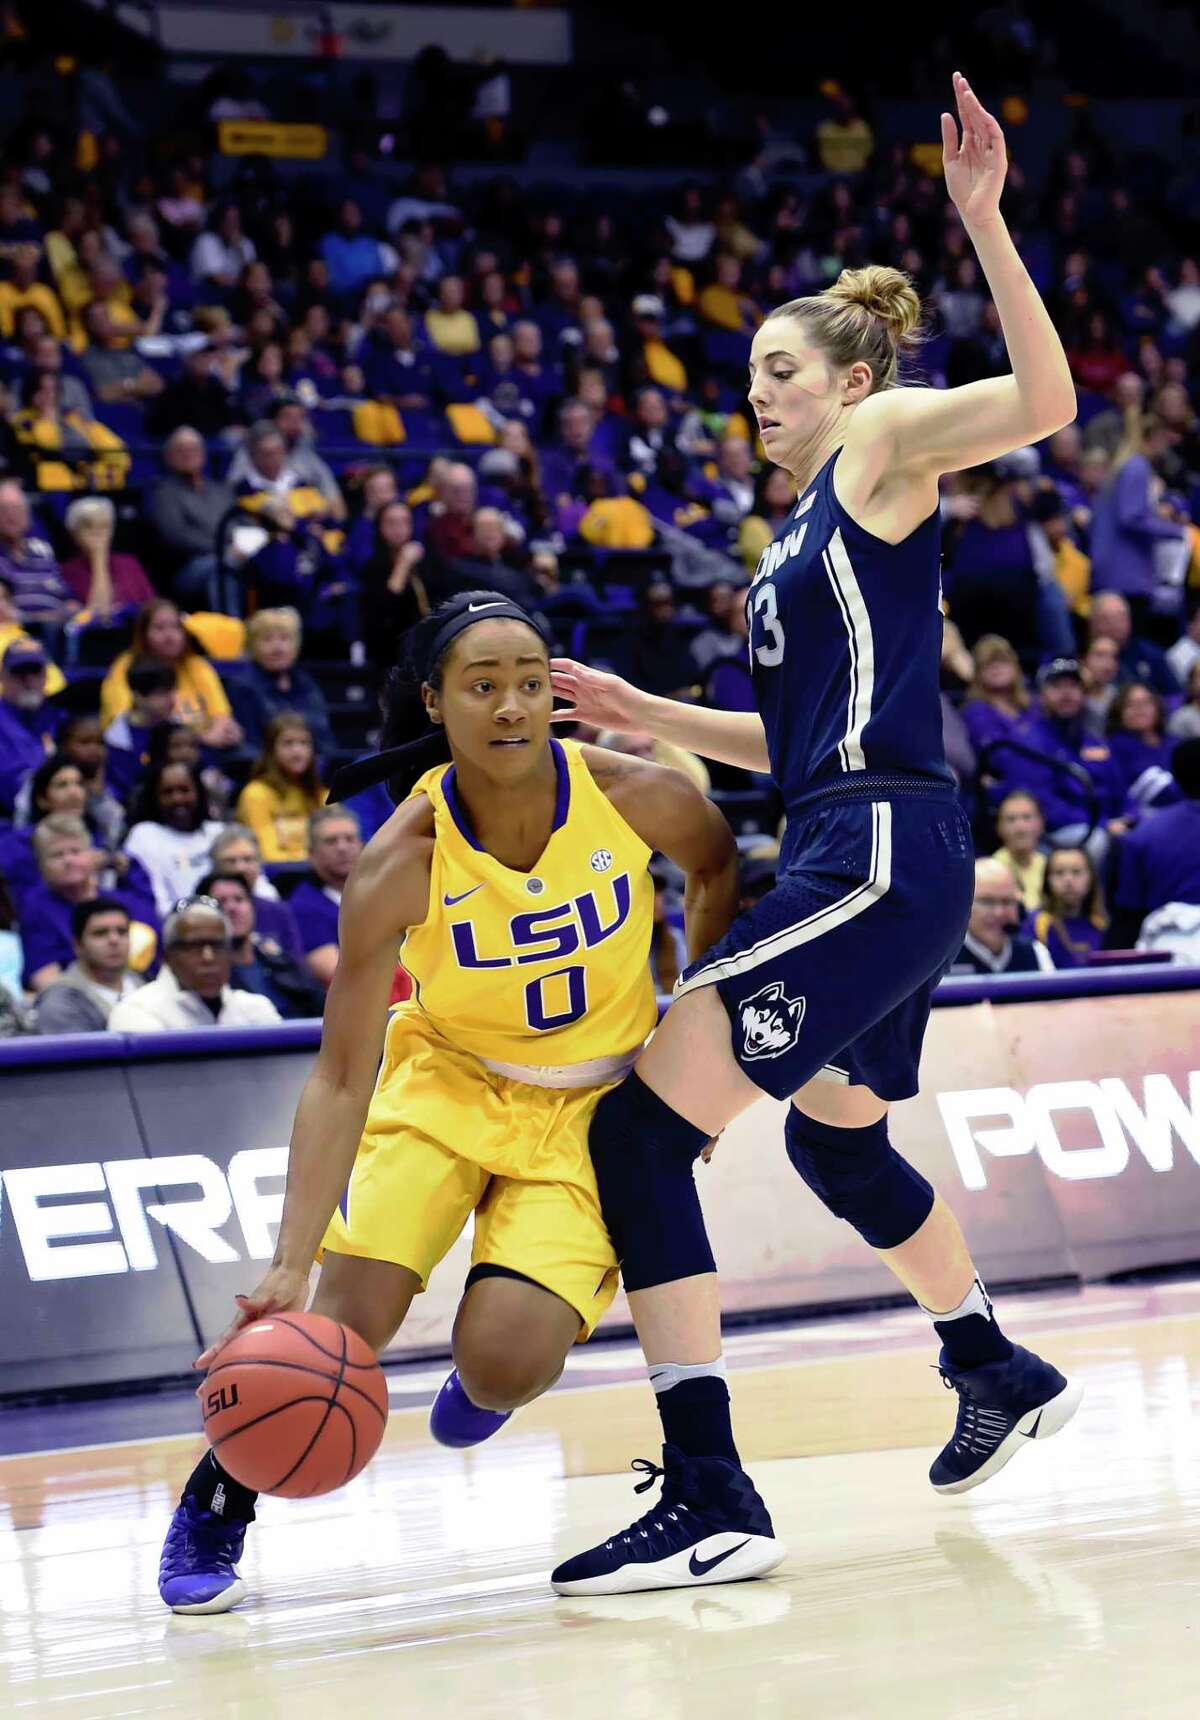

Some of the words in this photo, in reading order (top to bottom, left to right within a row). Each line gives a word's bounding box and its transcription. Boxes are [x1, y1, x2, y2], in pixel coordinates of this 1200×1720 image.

[748, 582, 785, 675] 3
[450, 872, 631, 969] LSU
[523, 964, 589, 1032] 0
[936, 1069, 1200, 1191] POW
[203, 1384, 239, 1423] SU
